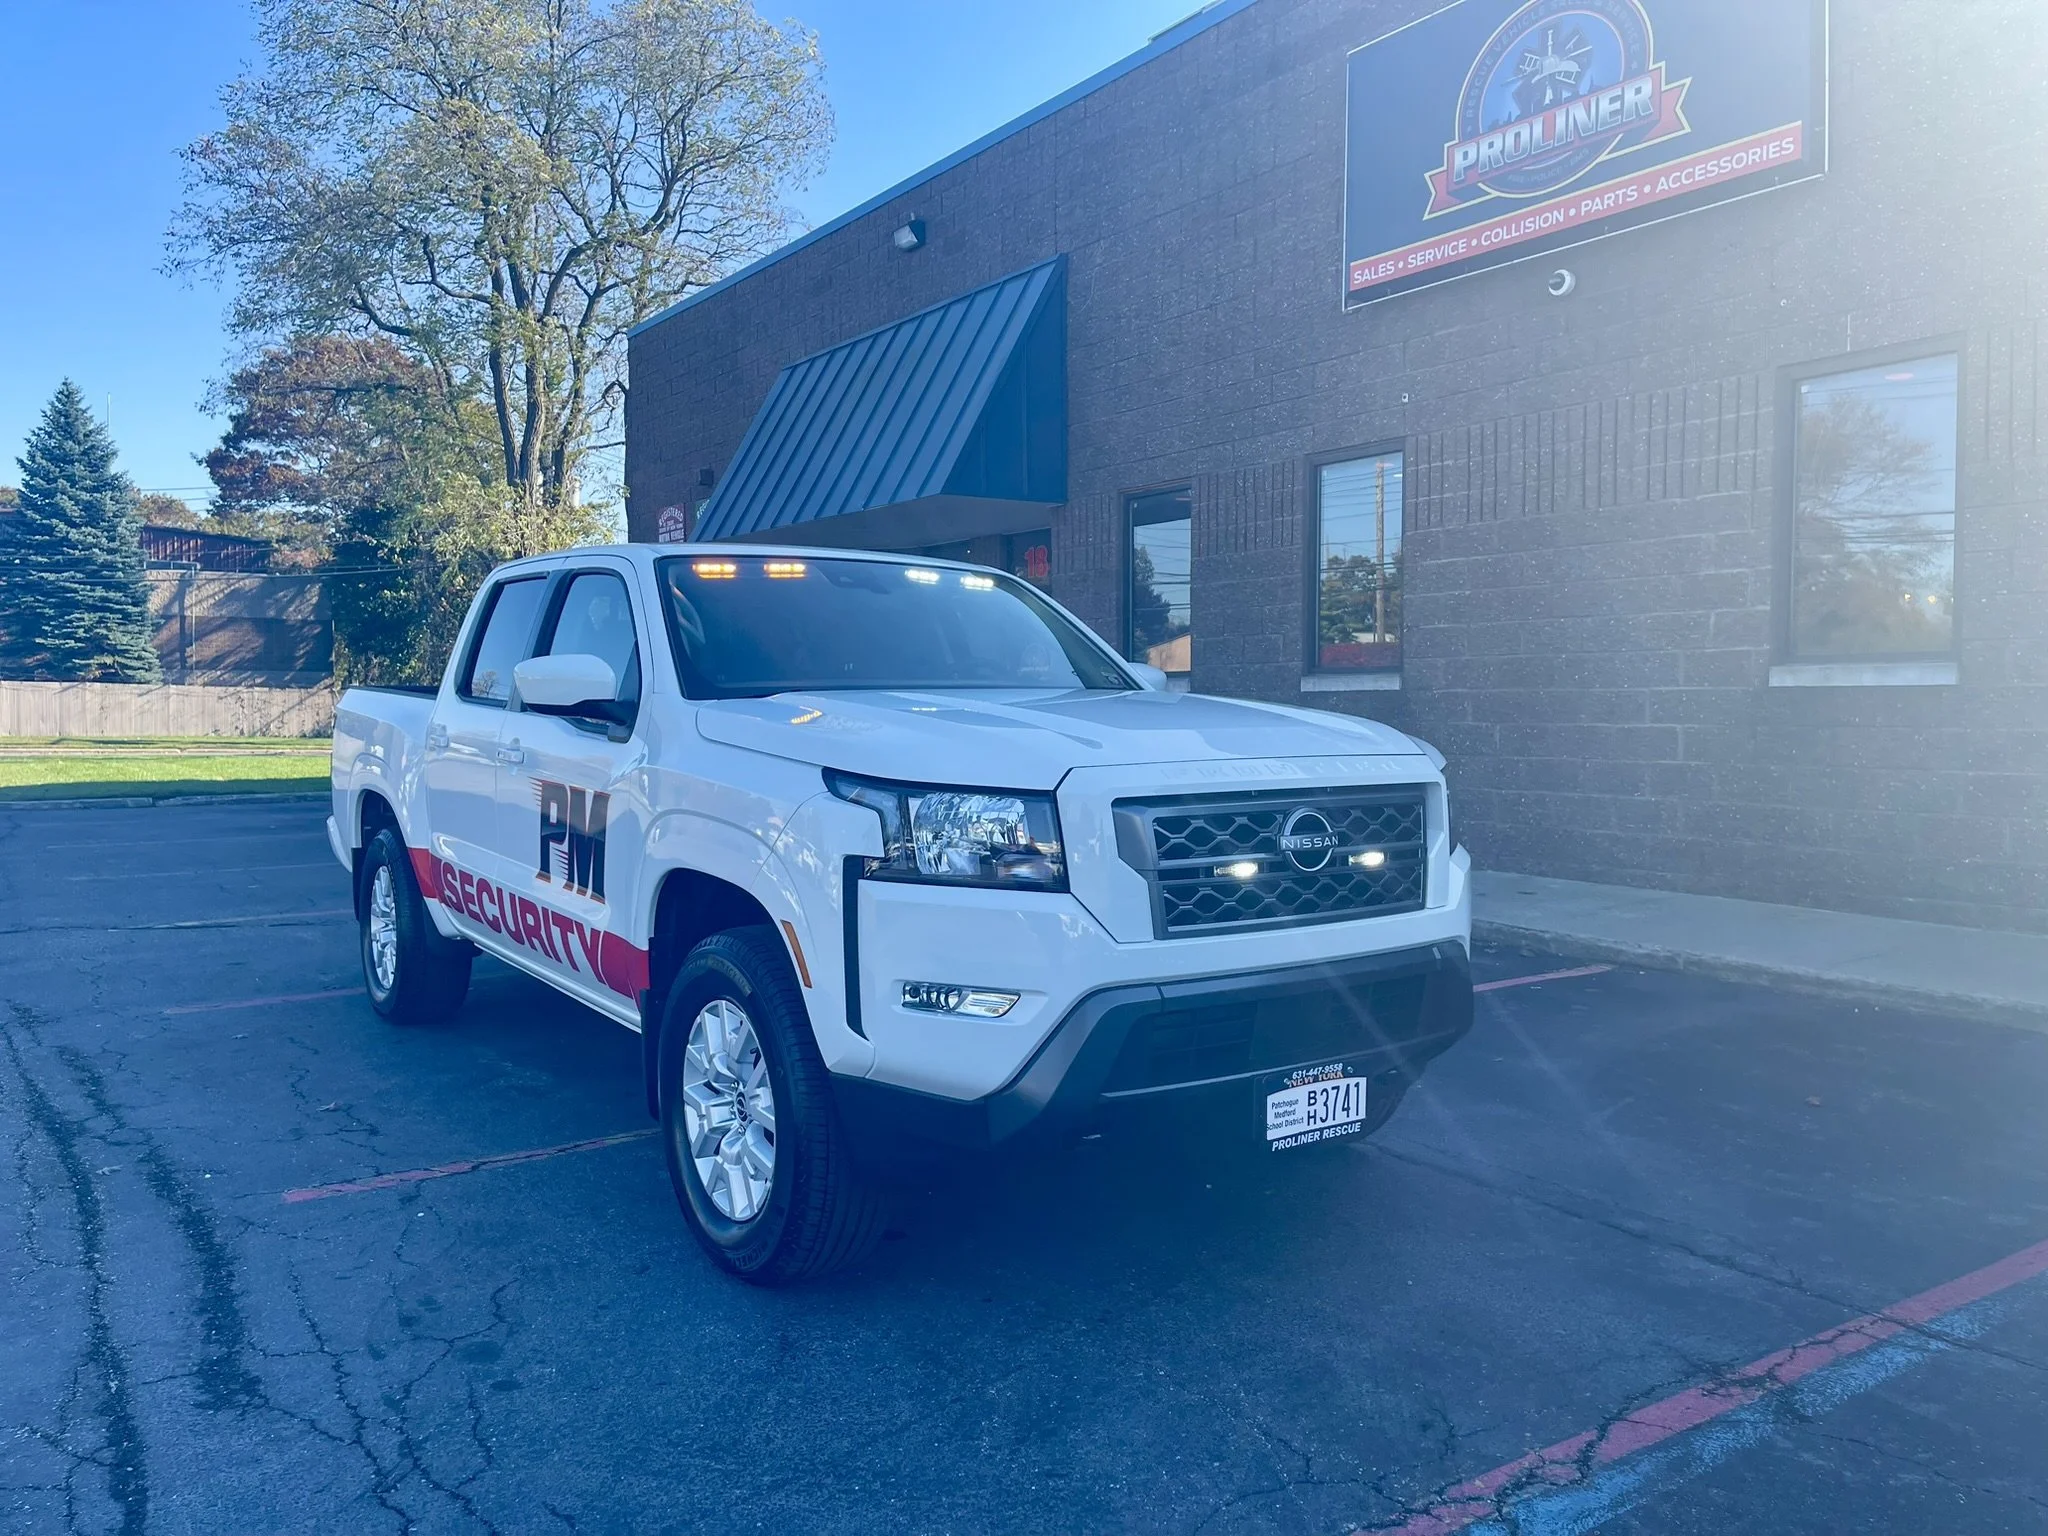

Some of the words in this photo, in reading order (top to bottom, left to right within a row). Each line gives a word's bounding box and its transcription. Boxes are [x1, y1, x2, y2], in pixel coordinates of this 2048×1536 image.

[1607, 1, 1640, 54] SERVICE
[1466, 56, 1494, 118] RESCUE
[1493, 4, 1545, 52] VEHICLE
[1453, 76, 1654, 182] PROLINER
[1353, 260, 1395, 284] SALES
[1407, 238, 1467, 268] SERVICE
[1481, 211, 1565, 246] COLLISION
[1580, 185, 1638, 216] PARTS
[1656, 137, 1794, 193] ACCESSORIES
[1024, 545, 1049, 578] 18
[529, 776, 611, 904] PM
[1282, 835, 1339, 850] NISSAN
[439, 861, 607, 985] SECURITY
[1292, 1063, 1343, 1080] 631-447-9558
[1271, 1099, 1299, 1110] Patchogue
[1274, 1109, 1297, 1119] Medford
[1320, 1081, 1360, 1123] 3741
[1266, 1120, 1284, 1131] School
[1284, 1116, 1304, 1128] District
[1272, 1130, 1321, 1152] PROLINER
[1322, 1122, 1361, 1140] RESCUE
